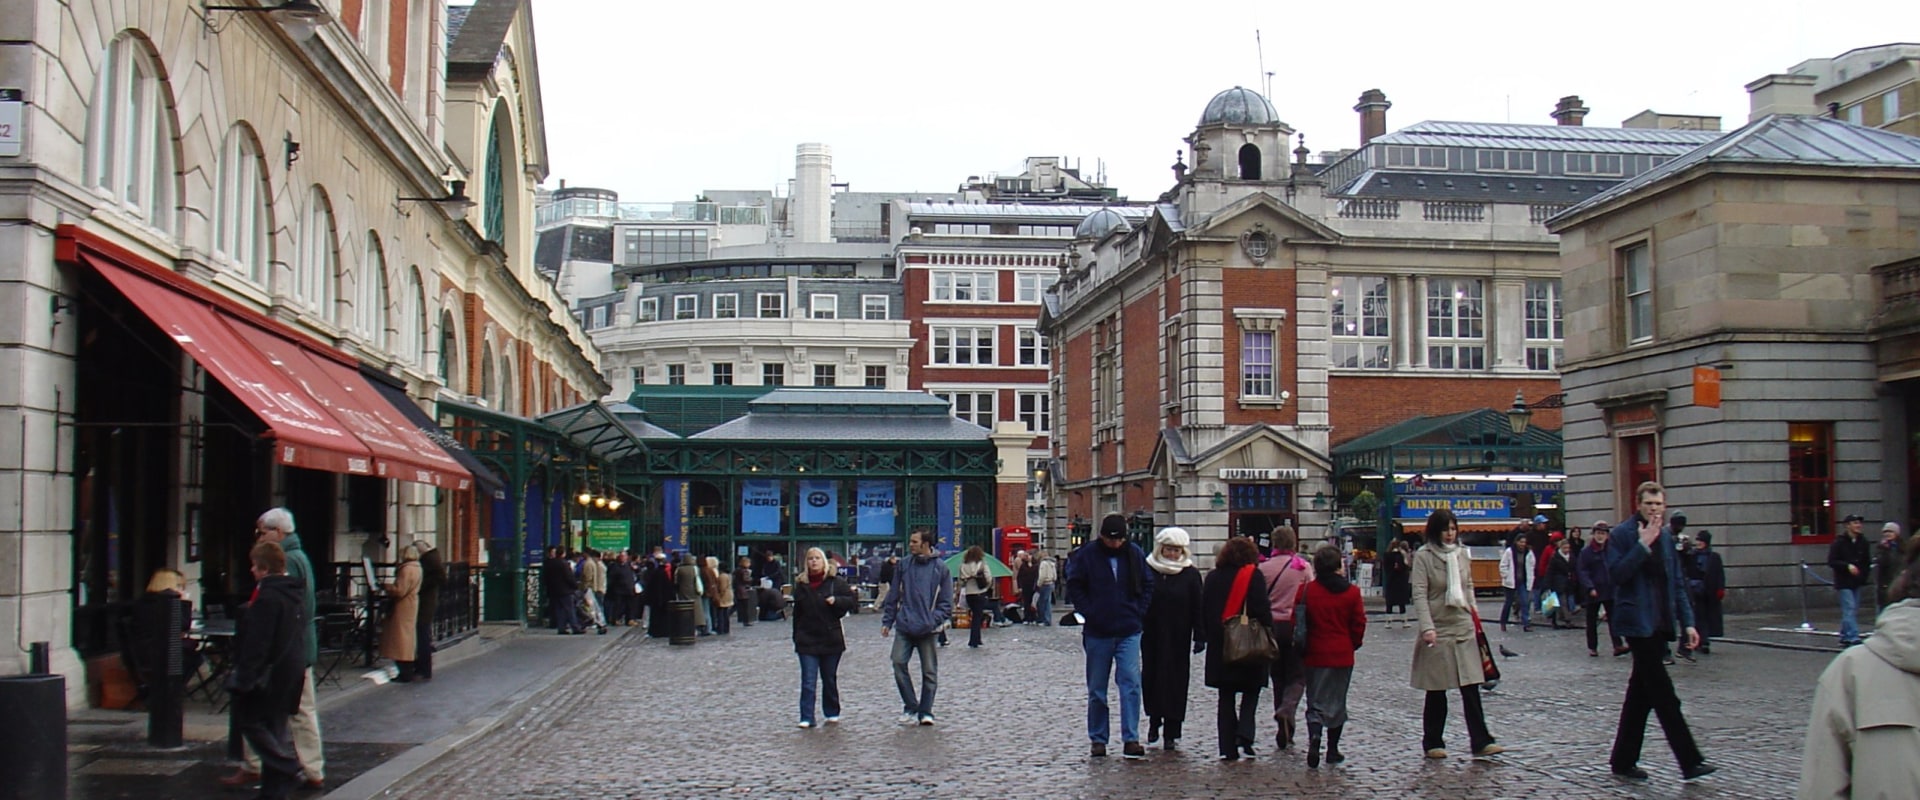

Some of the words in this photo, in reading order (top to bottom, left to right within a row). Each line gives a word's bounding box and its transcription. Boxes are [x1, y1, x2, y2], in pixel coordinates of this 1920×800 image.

[0, 124, 10, 137] 2
[1226, 470, 1269, 478] JUBILEE
[1277, 470, 1302, 478] HALL
[1440, 483, 1477, 491] MARKET
[1496, 483, 1529, 492] JUBILEE
[1531, 483, 1564, 491] MARKE
[680, 482, 690, 515] Museum
[744, 498, 778, 506] NERO
[953, 485, 962, 517] Museum
[859, 500, 893, 508] NERO
[1407, 499, 1451, 509] DINNER
[1454, 499, 1504, 509] JACKETS
[679, 525, 690, 546] Shop
[952, 527, 962, 547] Shop
